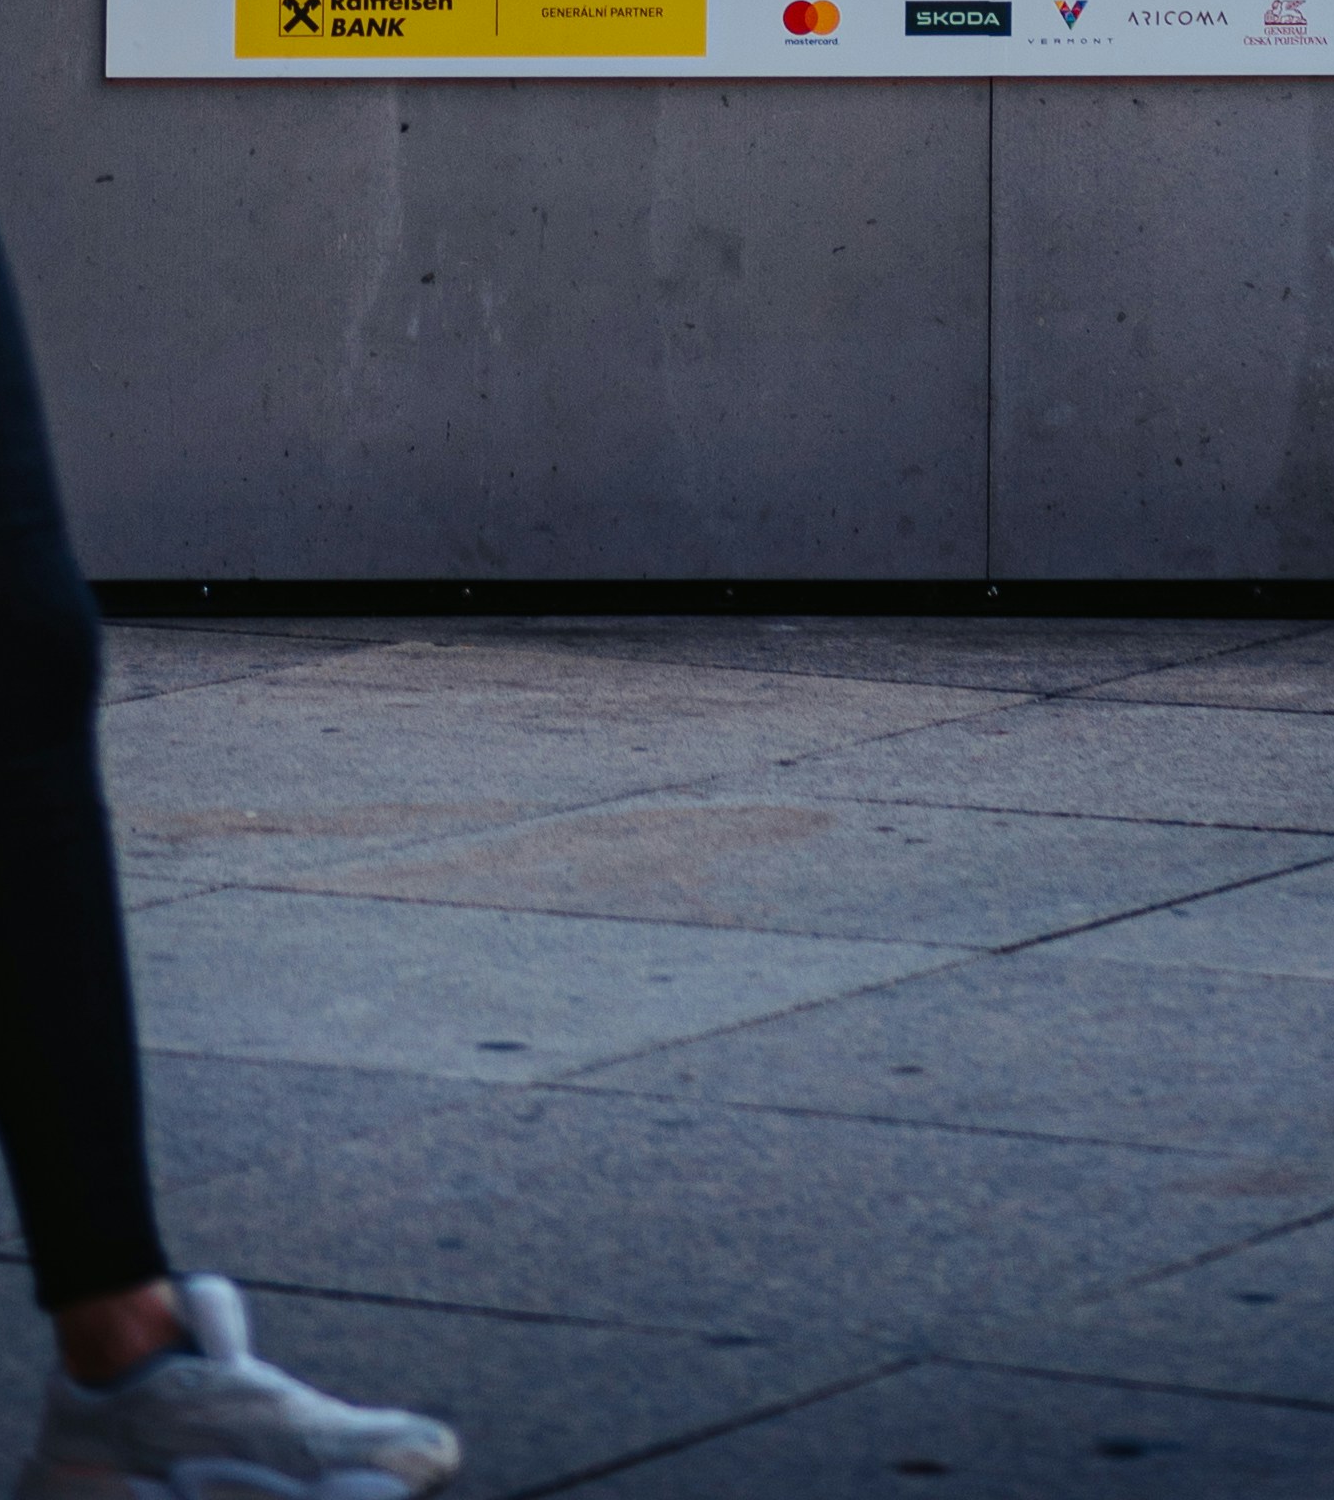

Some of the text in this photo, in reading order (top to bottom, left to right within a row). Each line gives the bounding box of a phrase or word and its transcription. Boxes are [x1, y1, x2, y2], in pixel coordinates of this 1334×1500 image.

[541, 6, 664, 18] GENERÁLNÍ PARTNER
[1128, 11, 1228, 26] ARICOMA
[331, 18, 405, 37] BANK
[1263, 26, 1308, 36] GENERALI
[1027, 37, 1114, 45] VERMONT
